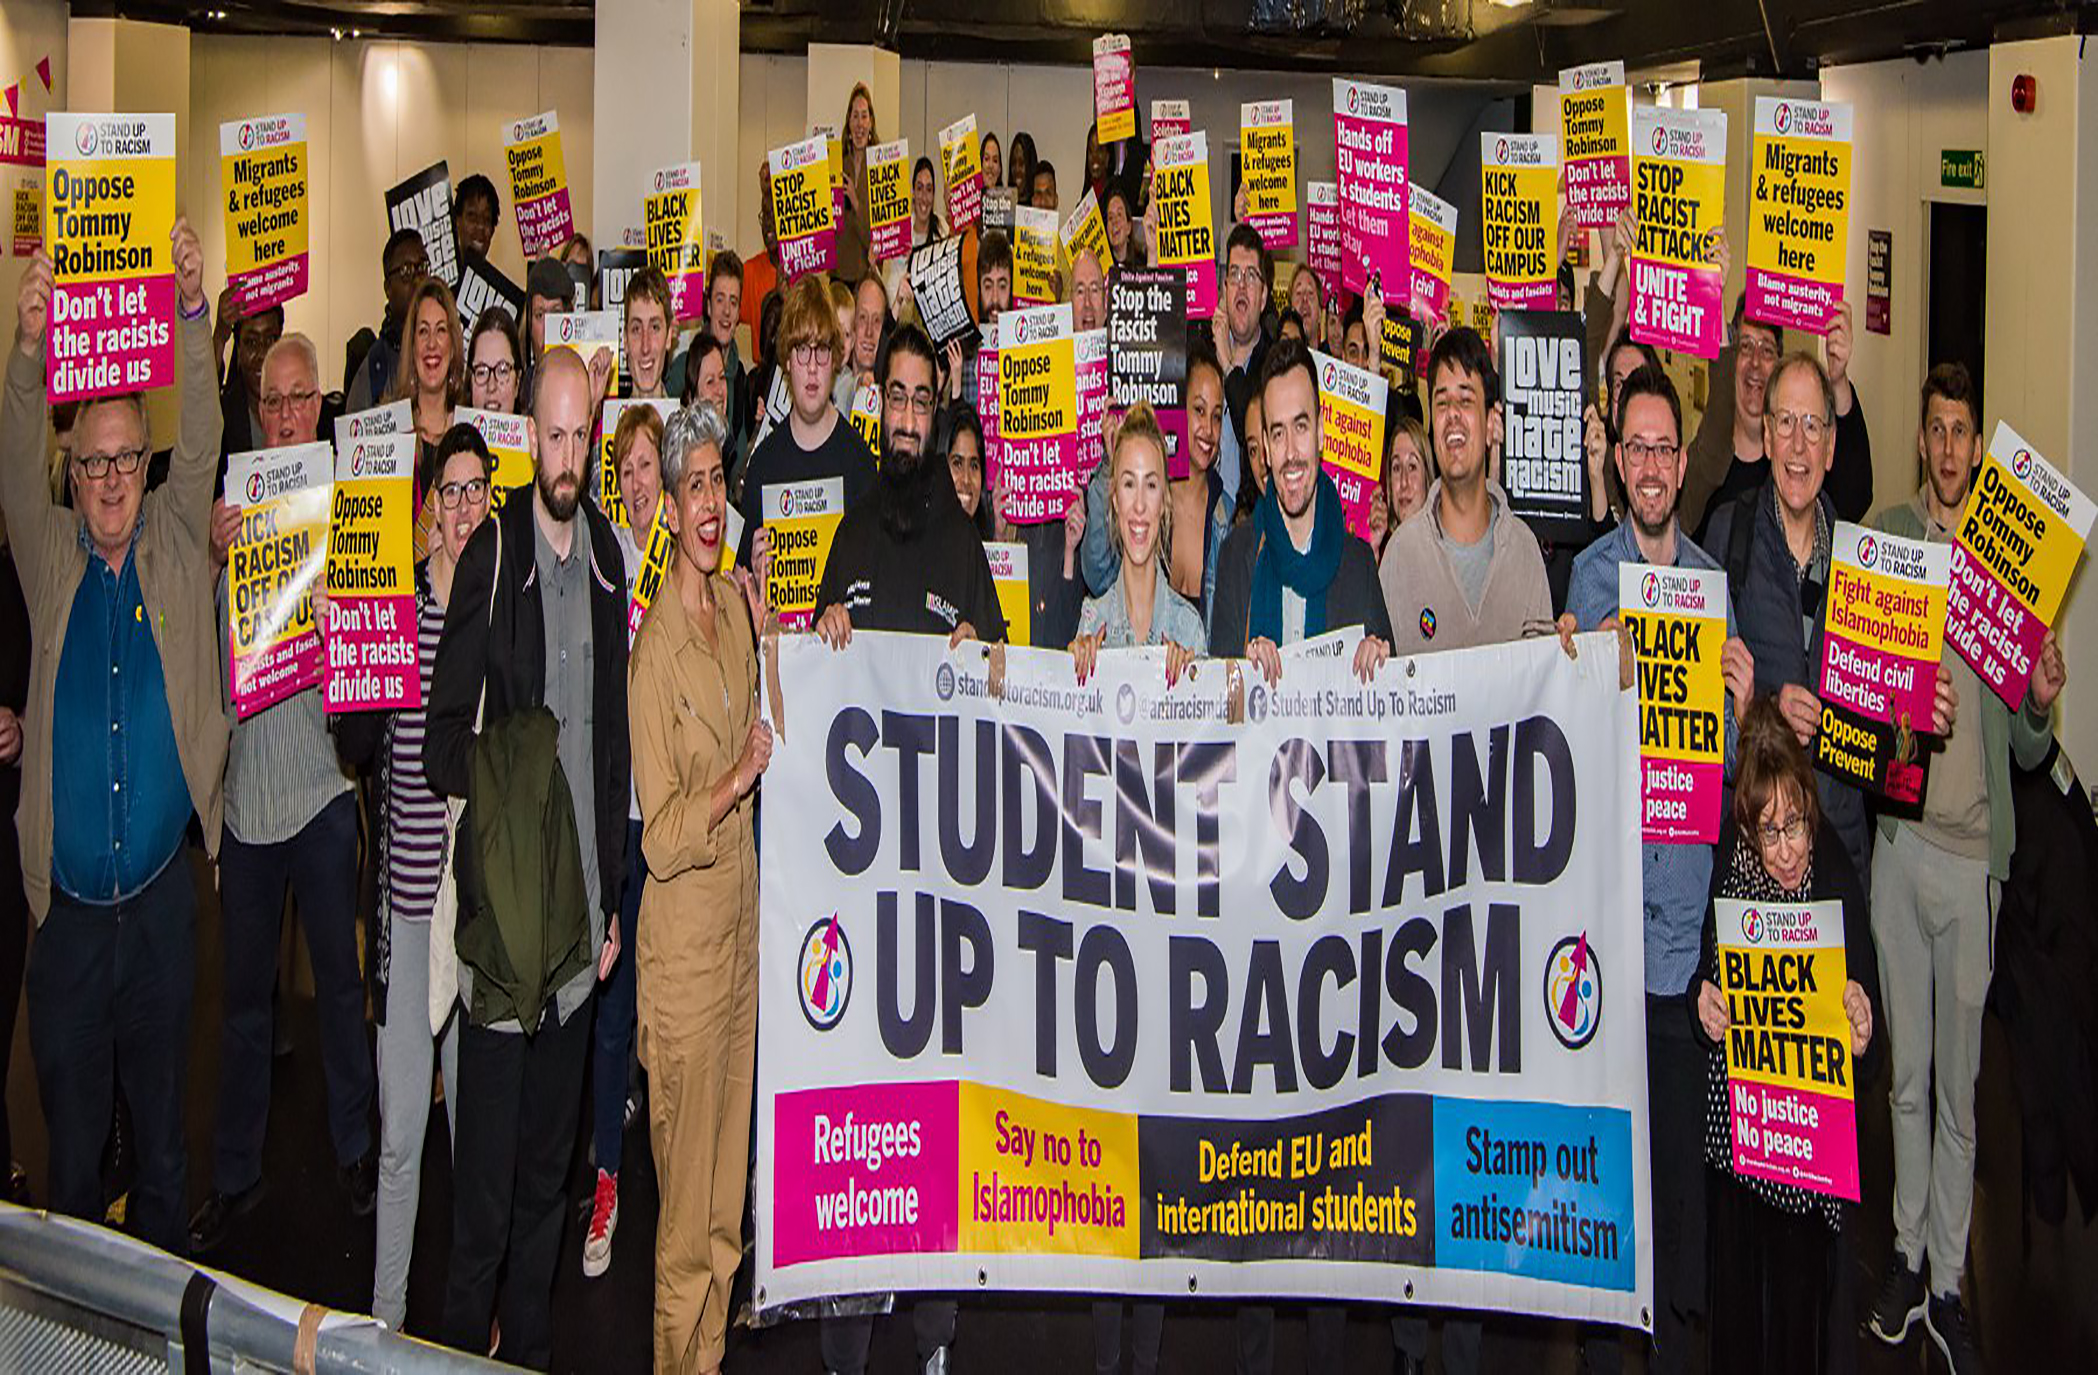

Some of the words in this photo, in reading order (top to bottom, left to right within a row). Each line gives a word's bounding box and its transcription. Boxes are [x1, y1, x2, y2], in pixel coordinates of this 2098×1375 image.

[1563, 97, 1605, 118] Oppose
[101, 123, 130, 136] STAND
[132, 124, 145, 136] UP
[1336, 122, 1371, 149] Hands
[1374, 130, 1394, 155] off
[1565, 116, 1604, 137] Tommy
[101, 141, 112, 154] TO
[115, 140, 150, 154] RACISM
[508, 145, 543, 167] Oppose
[1247, 132, 1286, 154] Migrants
[1566, 135, 1617, 157] Robinson
[234, 152, 298, 186] Migrants
[511, 164, 544, 184] Tommy
[869, 165, 901, 185] BLACK
[1243, 156, 1250, 169] &
[1252, 153, 1291, 172] refugees
[1338, 152, 1353, 174] EU
[1356, 159, 1404, 184] workers
[1765, 143, 1838, 177] Migrants
[1942, 159, 1957, 176] Fire
[1958, 159, 1972, 177] exit
[53, 168, 135, 208] Oppose
[513, 177, 556, 200] Robinson
[774, 173, 804, 197] STOP
[1155, 168, 1195, 200] BLACK
[1248, 177, 1288, 191] welcome
[1485, 171, 1517, 196] KICK
[1638, 162, 1683, 193] STOP
[229, 192, 240, 212] &
[243, 180, 304, 211] refugees
[647, 196, 688, 223] BLACK
[776, 190, 817, 217] RACIST
[870, 188, 897, 204] LIVES
[1258, 194, 1279, 209] here
[1339, 181, 1346, 196] &
[1348, 183, 1401, 212] students
[1756, 175, 1768, 200] &
[1772, 180, 1844, 213] refugees
[53, 207, 131, 241] Tommy
[238, 209, 298, 238] welcome
[779, 208, 829, 236] ATTACKS
[871, 198, 909, 224] MATTER
[1157, 199, 1190, 227] LIVES
[1340, 207, 1356, 226] Let
[1358, 212, 1388, 237] them
[1485, 201, 1540, 224] RACISM
[1637, 193, 1700, 228] RACIST
[648, 220, 682, 249] LIVES
[1486, 225, 1511, 249] OFF
[1514, 226, 1545, 250] OUR
[1763, 212, 1834, 241] welcome
[254, 238, 285, 262] here
[1159, 227, 1211, 258] MATTER
[1342, 229, 1362, 260] stay
[1778, 244, 1815, 272] here
[54, 243, 152, 275] Robinson
[1487, 252, 1546, 276] CAMPUS
[1635, 262, 1688, 302] UNITE
[1757, 273, 1785, 293] Blame
[53, 287, 112, 323] Don't
[119, 285, 147, 315] let
[1111, 284, 1144, 317] Stop
[1147, 284, 1172, 312] the
[1763, 294, 1779, 308] not
[1781, 298, 1824, 318] migrants
[1111, 313, 1157, 342] fascist
[1634, 295, 1647, 325] &
[1651, 301, 1704, 338] FIGHT
[53, 327, 90, 358] the
[97, 318, 169, 350] racists
[53, 362, 120, 394] divide
[127, 358, 151, 382] us
[1003, 354, 1051, 382] Oppose
[1111, 344, 1162, 381] Tommy
[1002, 380, 1049, 406] Tommy
[1113, 375, 1178, 405] Robinson
[1003, 407, 1063, 433] Robinson
[334, 489, 382, 527] Oppose
[1983, 466, 2046, 540] Oppose
[332, 525, 380, 560] Tommy
[1974, 492, 2034, 566] Tommy
[234, 530, 309, 582] RACISM
[1881, 541, 1909, 561] STAND
[1910, 548, 1924, 562] UP
[1962, 518, 2041, 606] Robinson
[326, 560, 397, 590] Robinson
[1881, 558, 1891, 573] TO
[1892, 561, 1927, 580] RACISM
[1834, 570, 1871, 606] Fight
[1875, 589, 1929, 619] against
[329, 602, 371, 632] Don't
[375, 602, 396, 631] let
[1831, 601, 1929, 650] Islamophobia
[329, 637, 358, 667] the
[361, 635, 414, 666] racists
[1624, 616, 1700, 662] BLACK
[1971, 607, 2031, 676] racists
[1828, 641, 1881, 682] Defend
[1884, 659, 1914, 691] civil
[328, 672, 380, 703] divide
[385, 674, 404, 699] us
[1825, 670, 1885, 712] liberties
[1272, 689, 1322, 718] Student
[1326, 689, 1363, 717] Stand
[1368, 688, 1386, 722] Up
[1389, 689, 1405, 716] To
[1409, 688, 1456, 715] Racism
[1821, 707, 1877, 751] Oppose
[1819, 736, 1875, 781] Prevent
[1646, 762, 1693, 792] justice
[824, 706, 1236, 918] STUDENT
[1269, 715, 1577, 920] STAND
[1646, 798, 1687, 822] peace
[1766, 912, 1796, 926] STAND
[1798, 915, 1811, 926] UP
[1767, 927, 1780, 941] TO
[1782, 926, 1817, 941] RACISM
[1725, 951, 1817, 993] BLACK
[876, 890, 994, 1059] UP
[1018, 910, 1138, 1089] TO
[1168, 903, 1521, 1094] RACISM
[1729, 996, 1805, 1028] LIVES
[1731, 1029, 1846, 1087] MATTER
[1735, 1084, 1757, 1114] No
[1762, 1091, 1818, 1128] justice
[814, 1114, 921, 1171] Refugees
[995, 1111, 1035, 1169] Say
[1043, 1131, 1071, 1167] no
[1079, 1130, 1101, 1167] to
[1199, 1133, 1282, 1184] Defend
[1291, 1133, 1323, 1179] EU
[1329, 1119, 1371, 1170] and
[1736, 1117, 1759, 1148] No
[1763, 1130, 1813, 1160] peace
[1465, 1126, 1547, 1189] Stamp
[1556, 1135, 1599, 1185] out
[816, 1178, 918, 1231] welcome
[973, 1172, 1125, 1236] Islamophobia
[1157, 1191, 1304, 1237] international
[1311, 1181, 1417, 1237] students
[1451, 1193, 1618, 1261] antisemitism
